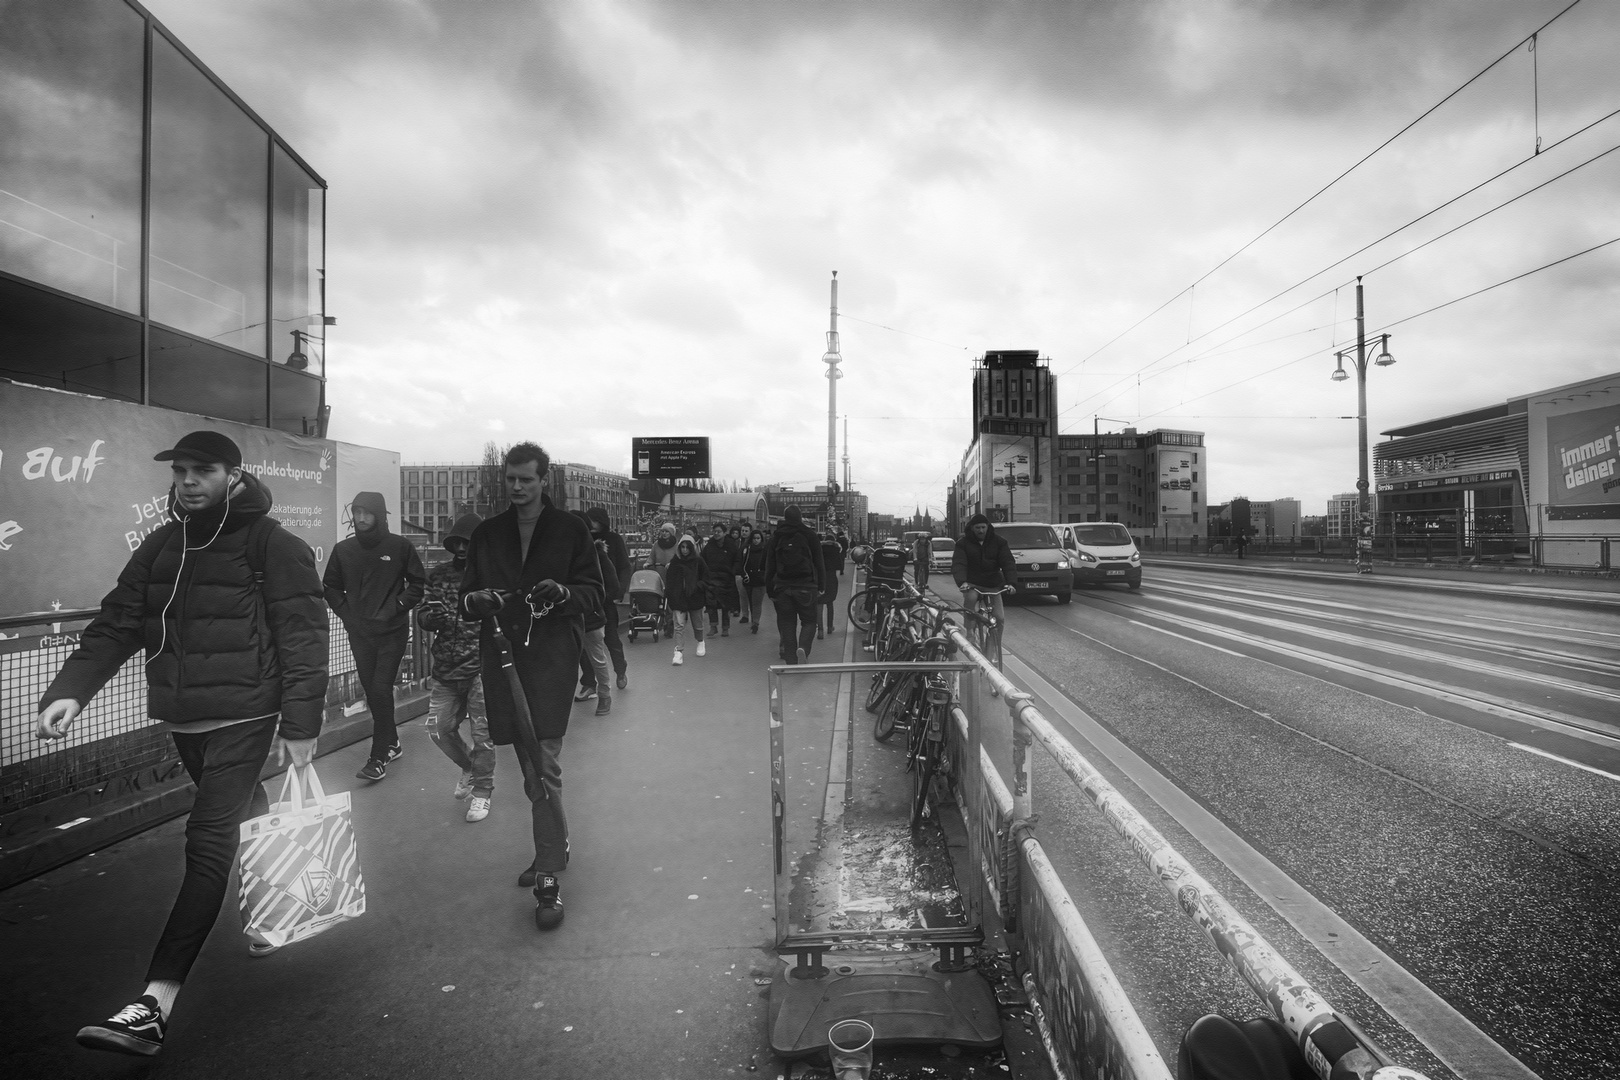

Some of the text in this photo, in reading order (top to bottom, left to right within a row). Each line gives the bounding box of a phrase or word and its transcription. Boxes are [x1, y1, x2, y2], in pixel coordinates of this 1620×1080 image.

[22, 439, 105, 483] auf
[1560, 434, 1612, 468] immer
[1565, 458, 1616, 489] deiner
